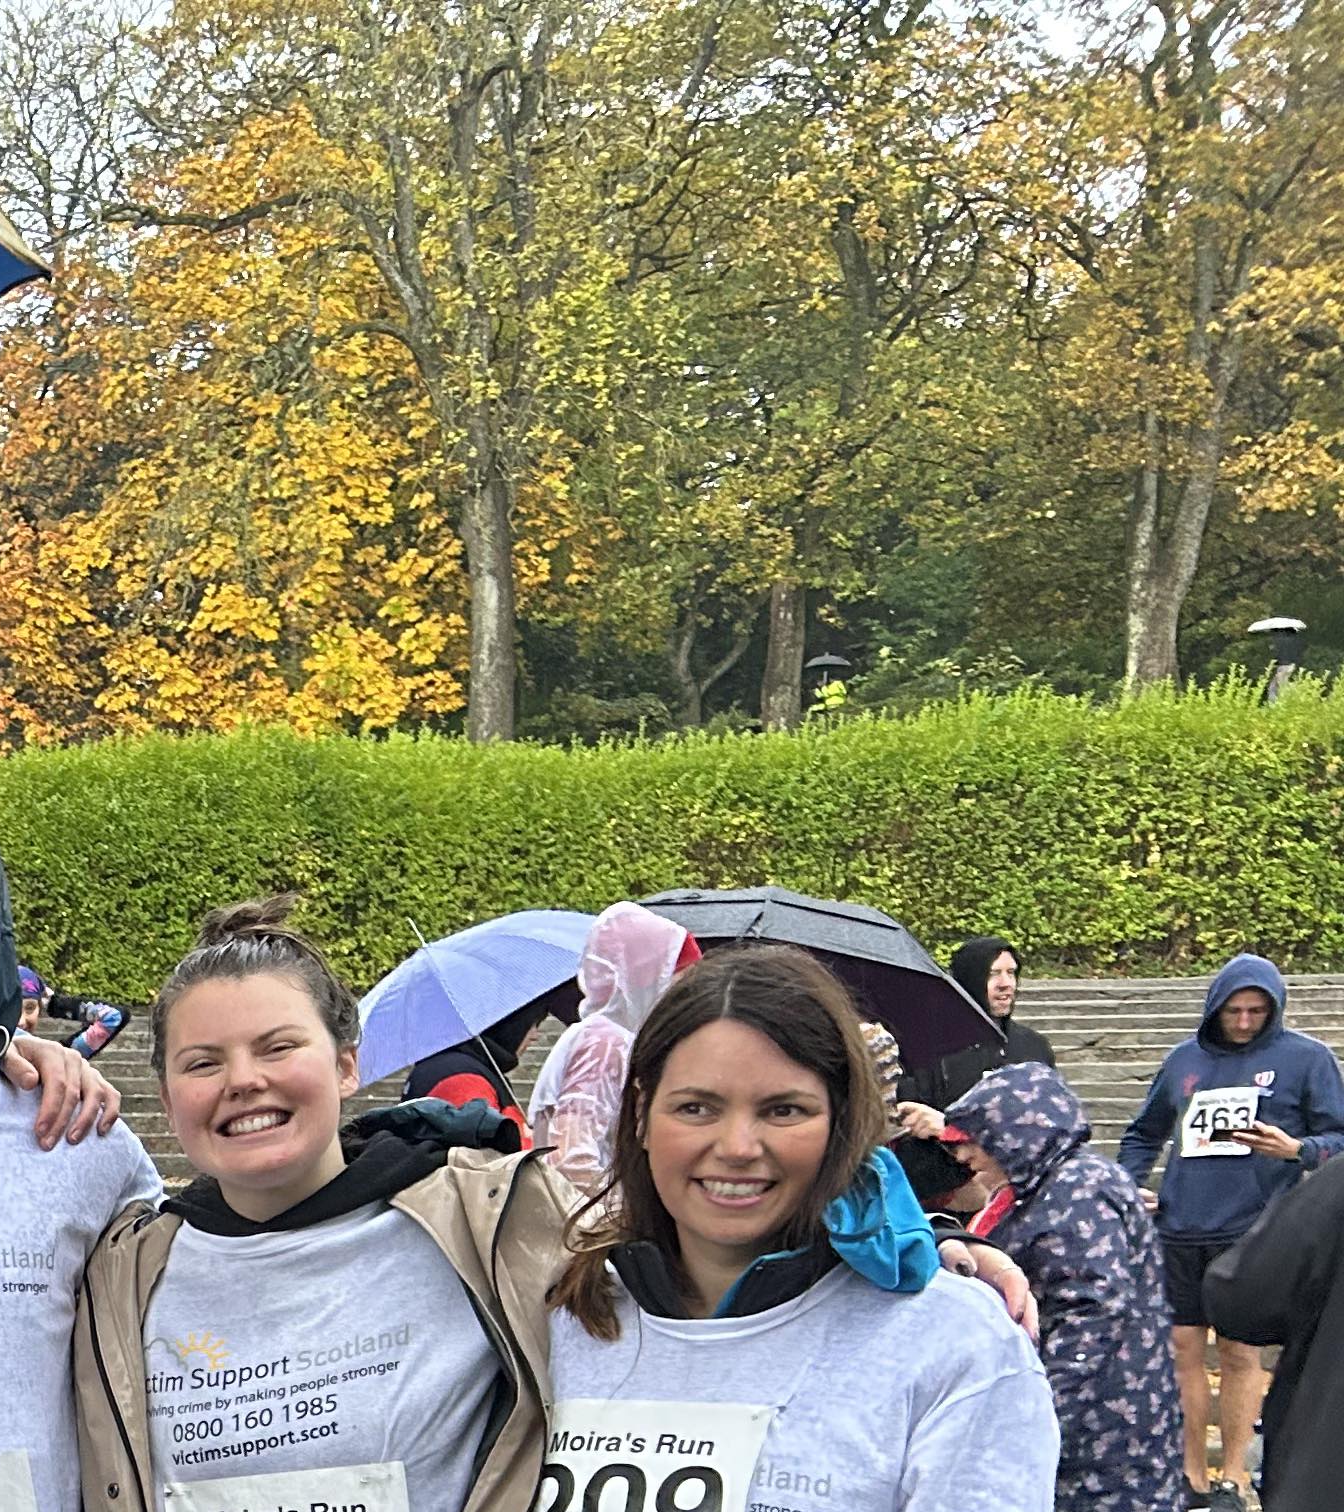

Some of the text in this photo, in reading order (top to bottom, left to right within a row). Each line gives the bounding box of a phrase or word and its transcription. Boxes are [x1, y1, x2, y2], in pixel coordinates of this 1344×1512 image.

[1190, 1106, 1250, 1133] 463
[2, 1281, 49, 1295] stronger
[145, 1323, 411, 1394] ctim Support Scotland
[177, 1399, 212, 1417] crime
[214, 1391, 231, 1411] by
[234, 1385, 286, 1408] making
[289, 1373, 338, 1398] people
[341, 1359, 400, 1383] stronger
[172, 1393, 338, 1443] 0800 160 1985
[171, 1420, 339, 1466] victimsupport.scot
[549, 1431, 714, 1456] Moira's Run
[754, 1462, 831, 1497] tland
